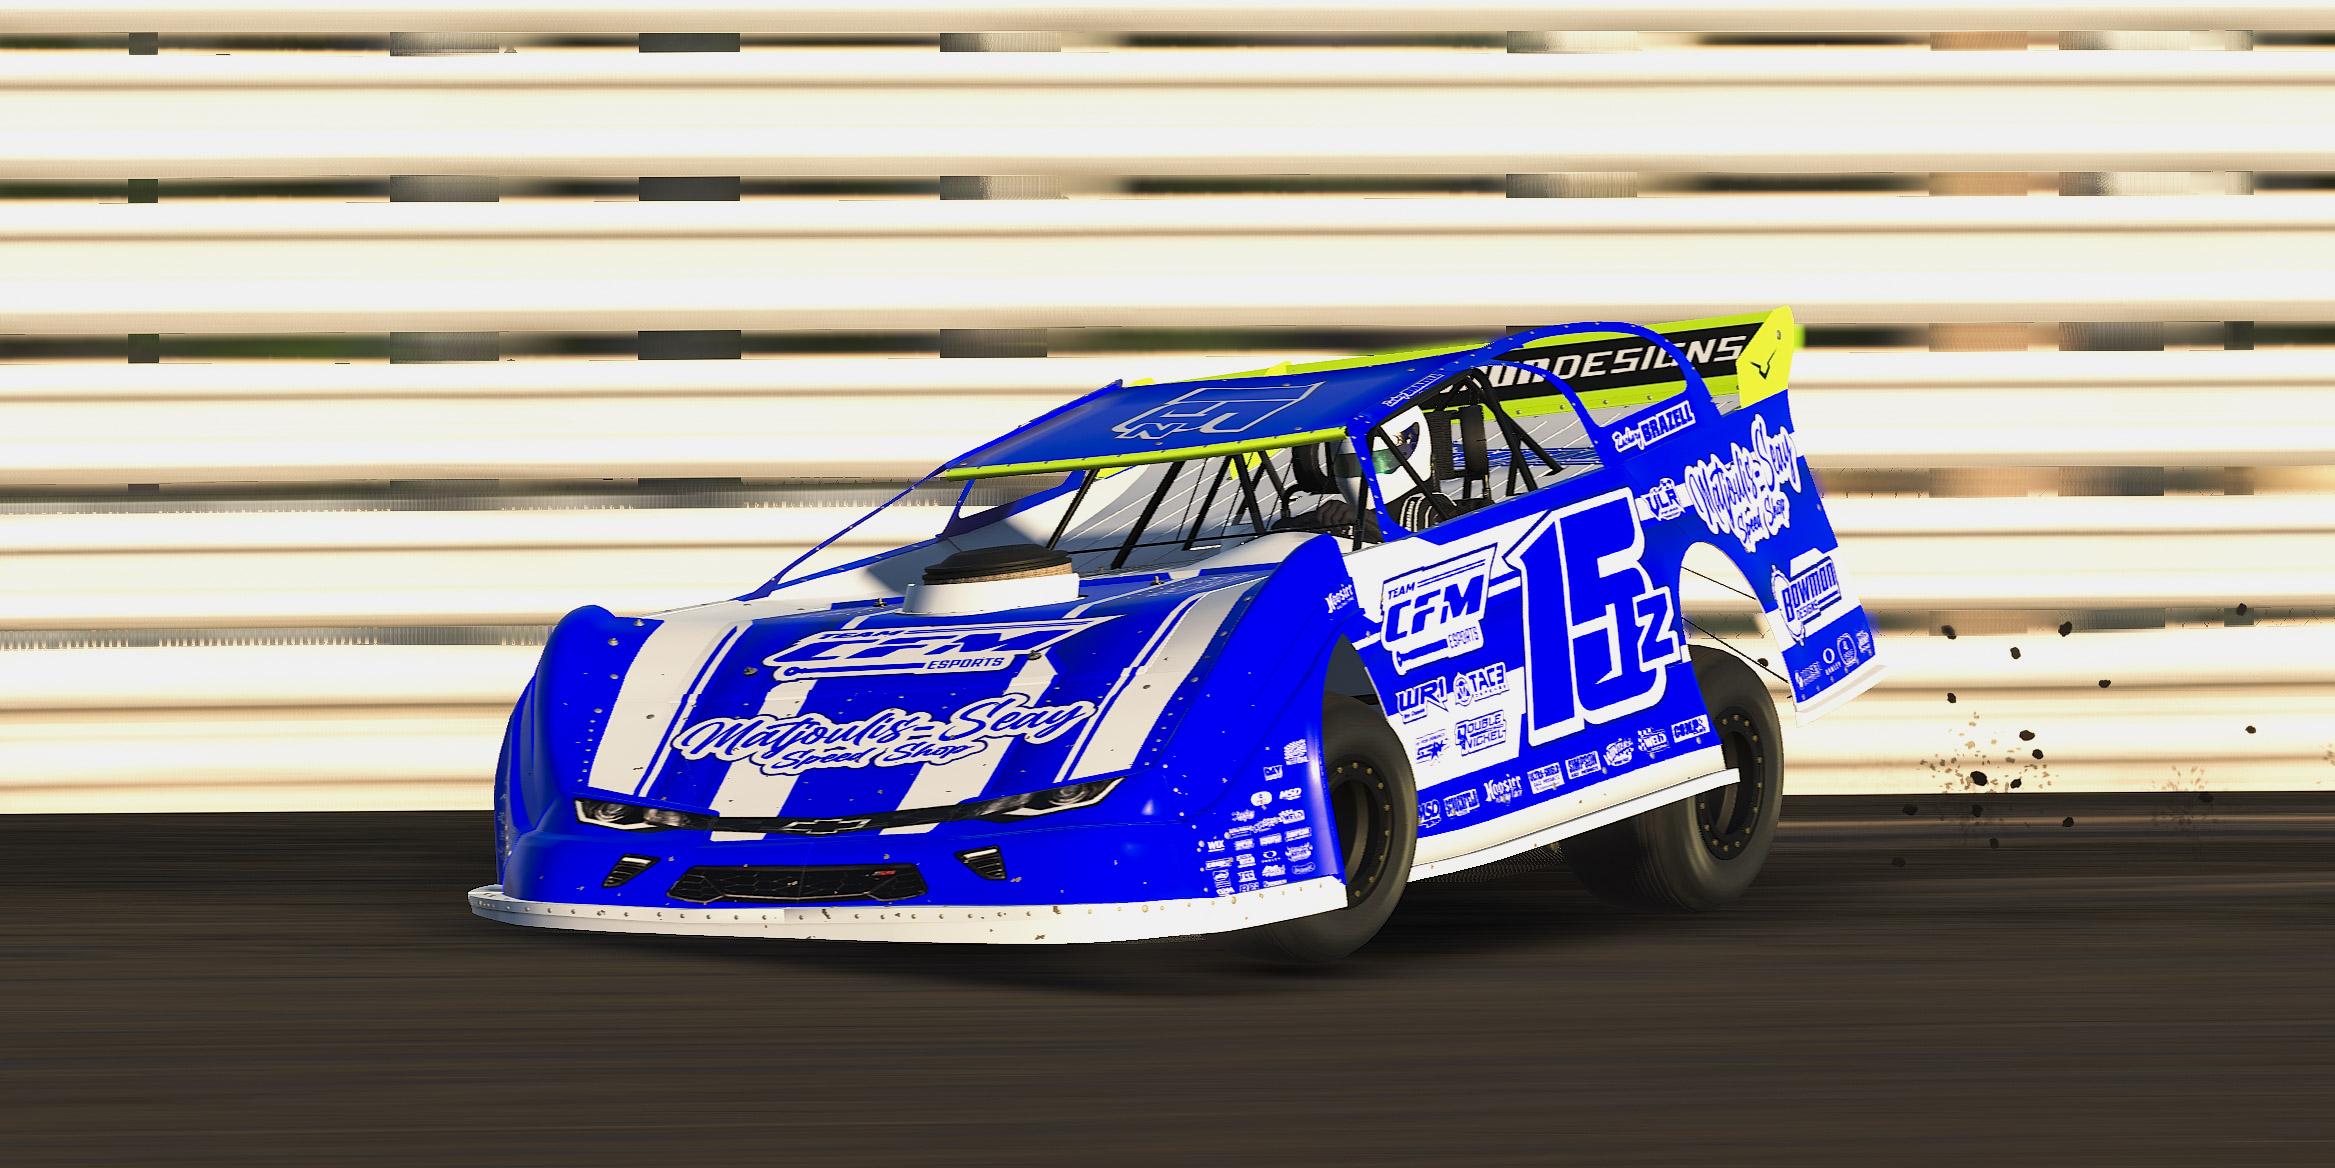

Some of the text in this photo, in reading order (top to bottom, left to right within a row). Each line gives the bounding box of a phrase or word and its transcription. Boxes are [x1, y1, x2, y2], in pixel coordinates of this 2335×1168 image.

[1640, 404, 1693, 442] BRAZELL
[1388, 581, 1416, 600] TEAM
[1385, 574, 1485, 643] CFM
[1448, 626, 1479, 649] ESPORTS
[927, 656, 1005, 670] ESPORTS
[774, 741, 974, 770] Speed Shop
